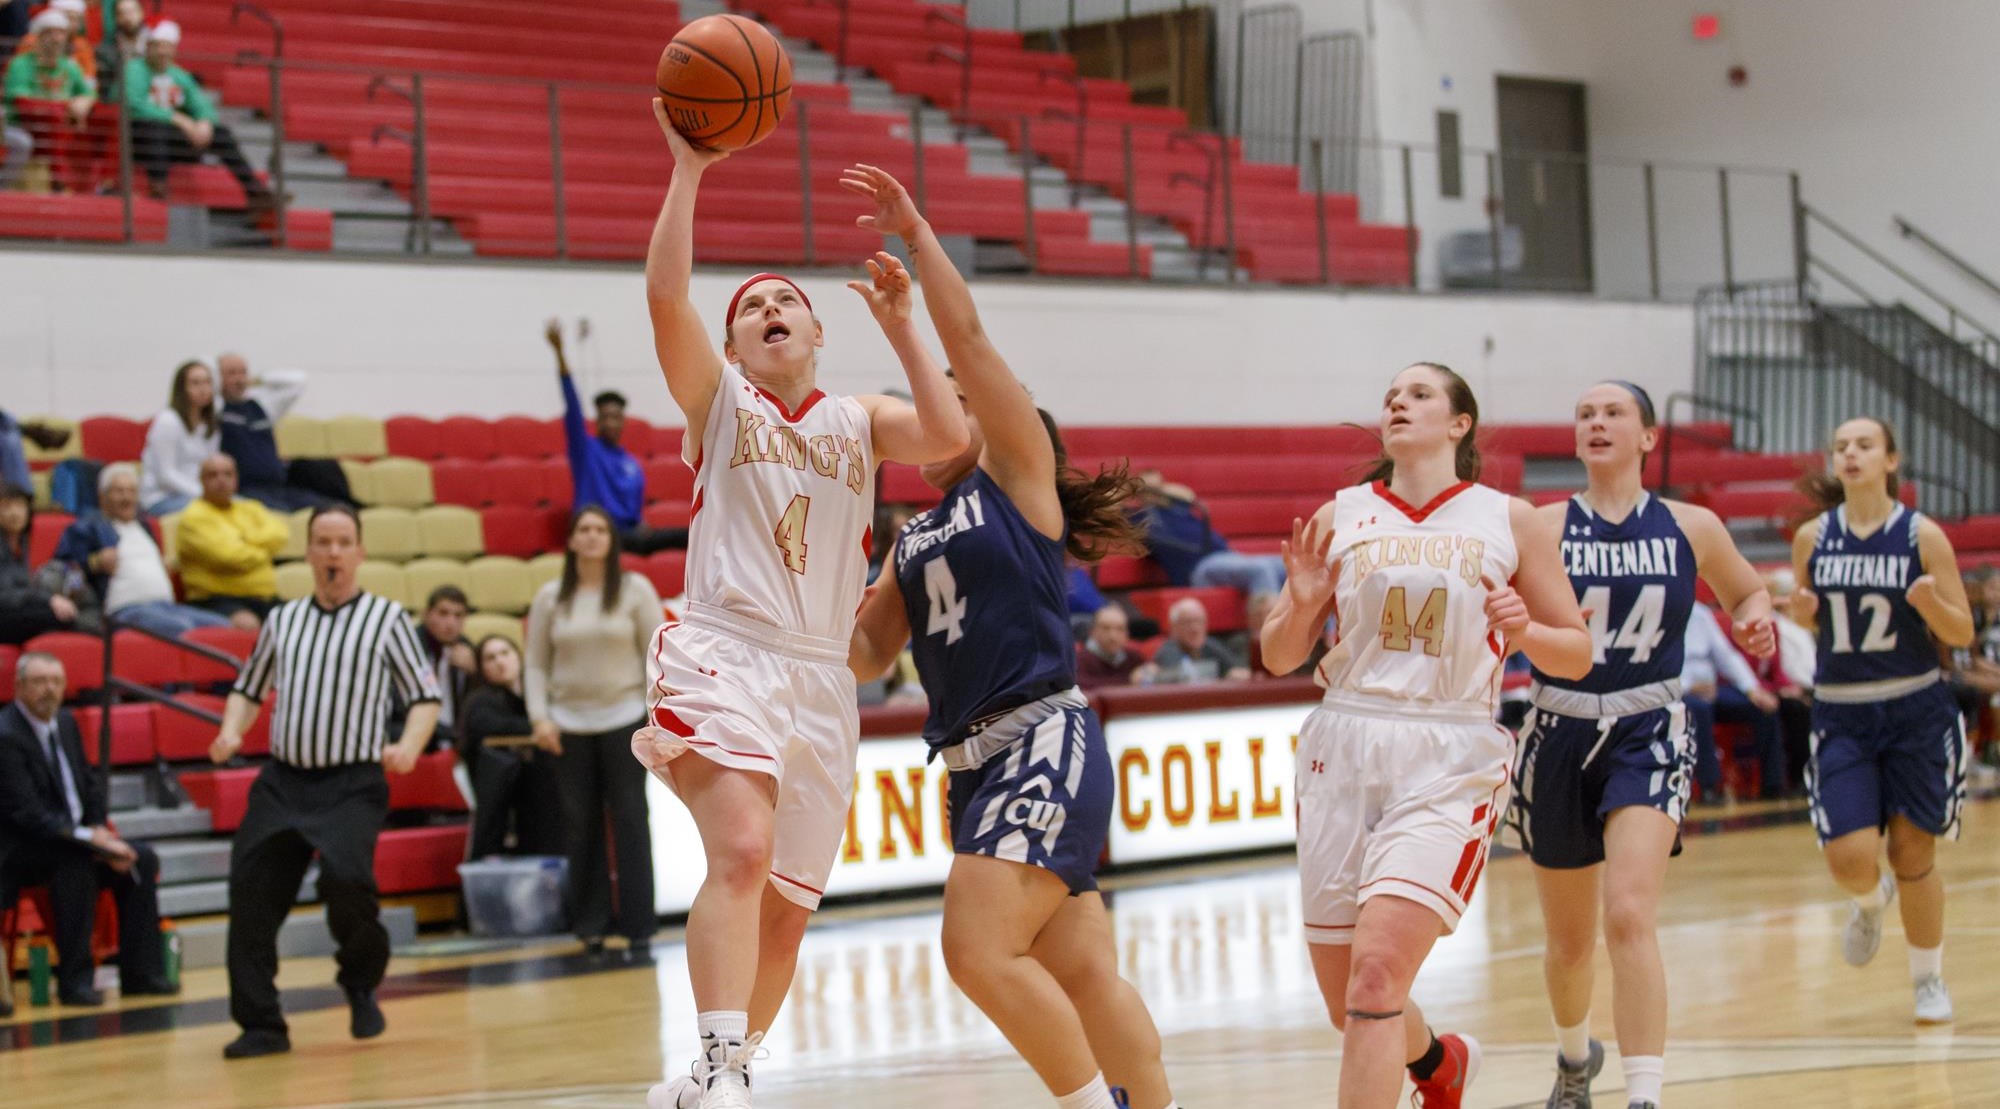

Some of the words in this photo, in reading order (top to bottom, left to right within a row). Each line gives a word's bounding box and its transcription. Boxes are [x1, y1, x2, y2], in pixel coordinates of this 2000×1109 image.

[730, 408, 865, 495] KING'S
[775, 494, 810, 575] 4
[1353, 534, 1485, 588] KING'S
[1561, 537, 1677, 577] CENTENARY
[1814, 554, 1910, 588] CENTENARY
[924, 554, 967, 646] 4
[1379, 586, 1447, 657] 44
[1580, 584, 1666, 664] 44
[1824, 591, 1898, 653] 12
[1119, 735, 1299, 831] COLL
